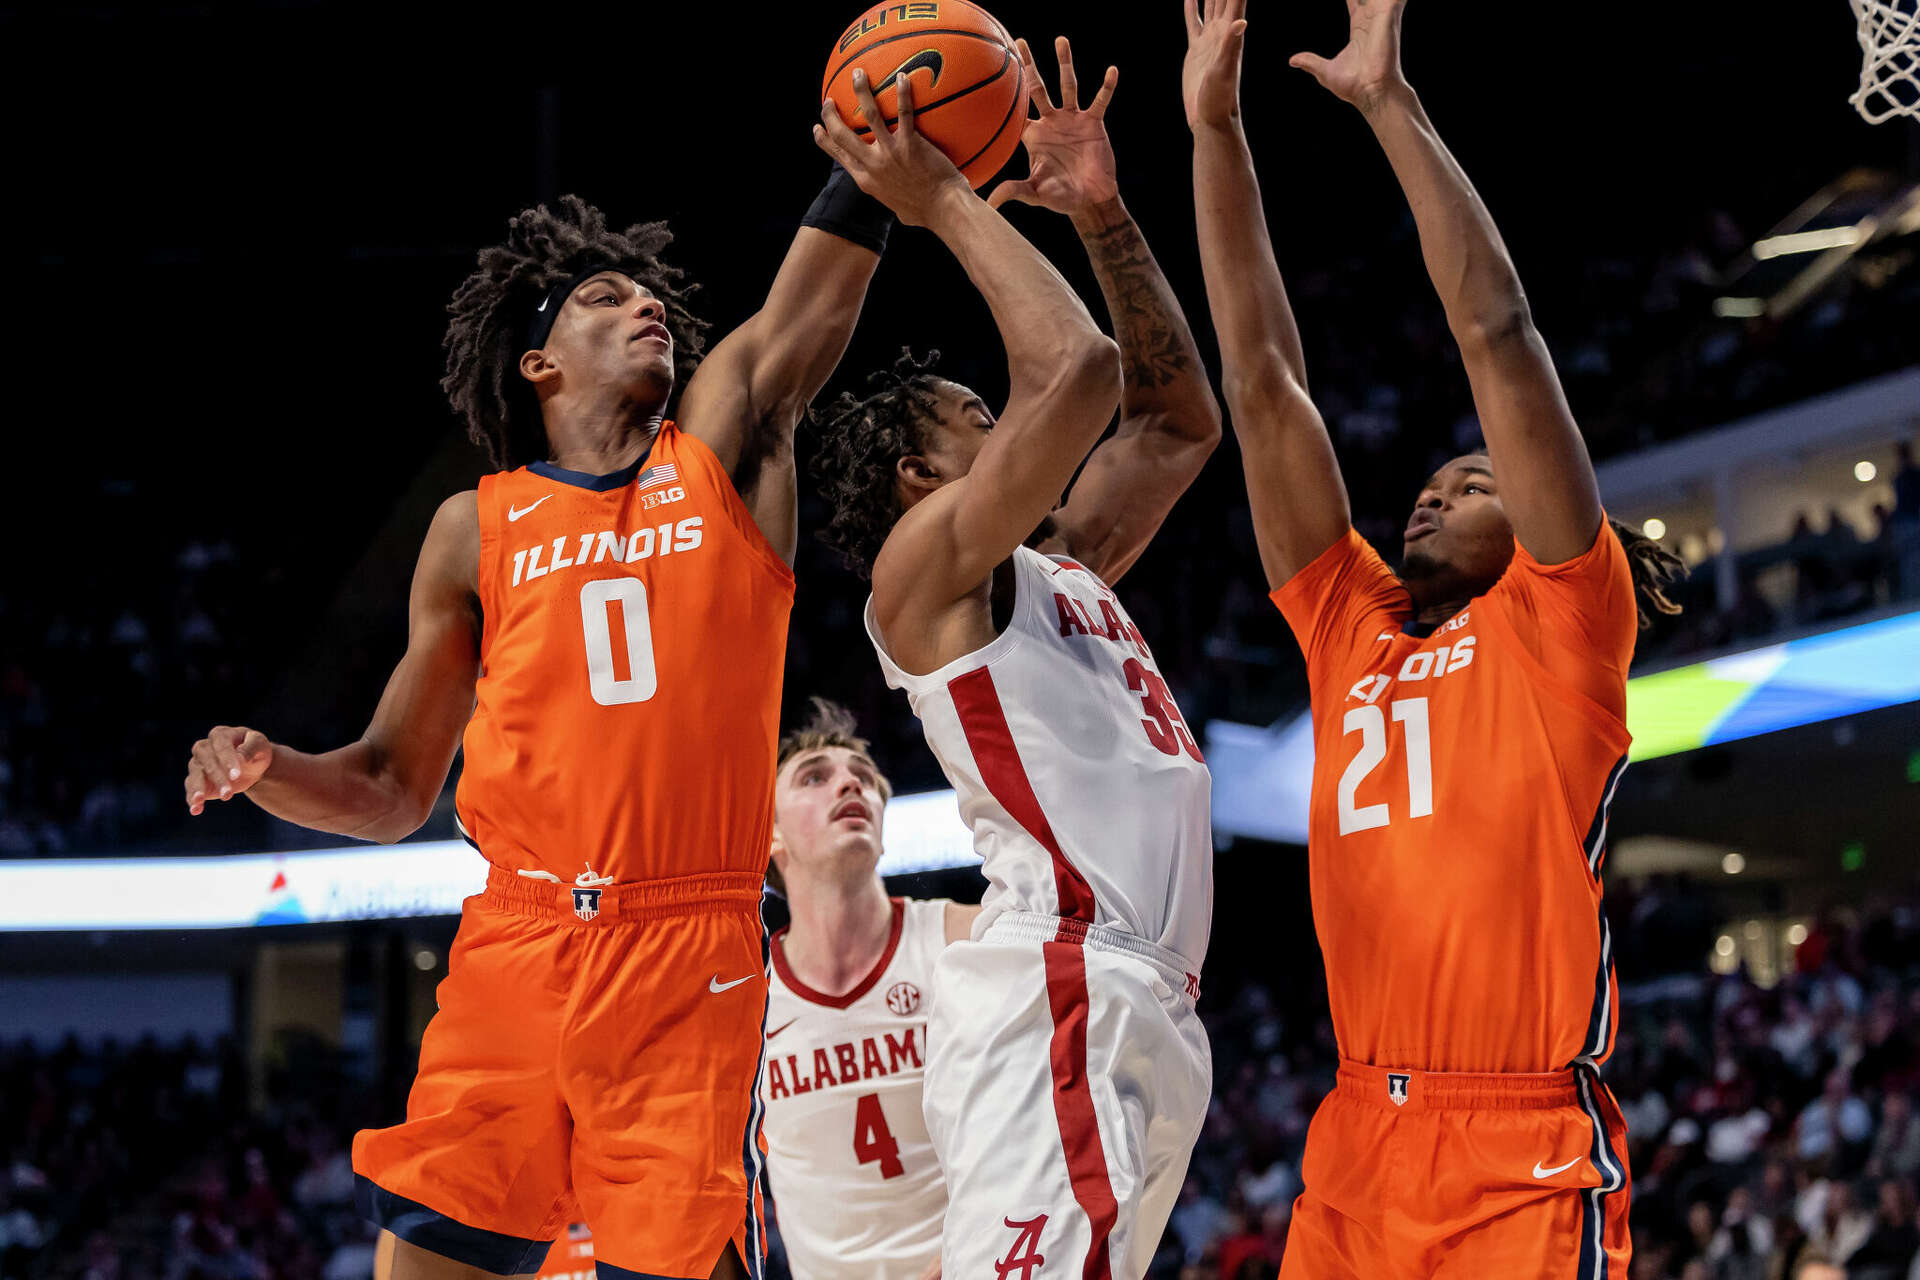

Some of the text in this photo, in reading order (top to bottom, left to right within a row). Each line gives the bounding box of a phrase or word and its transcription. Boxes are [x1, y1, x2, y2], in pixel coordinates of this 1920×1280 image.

[839, 2, 939, 54] ELITE
[512, 516, 704, 588] ILLINOIS
[580, 577, 657, 706] 0
[1337, 697, 1433, 837] 21
[768, 1023, 927, 1101] ALABAM
[853, 1092, 905, 1180] 4
